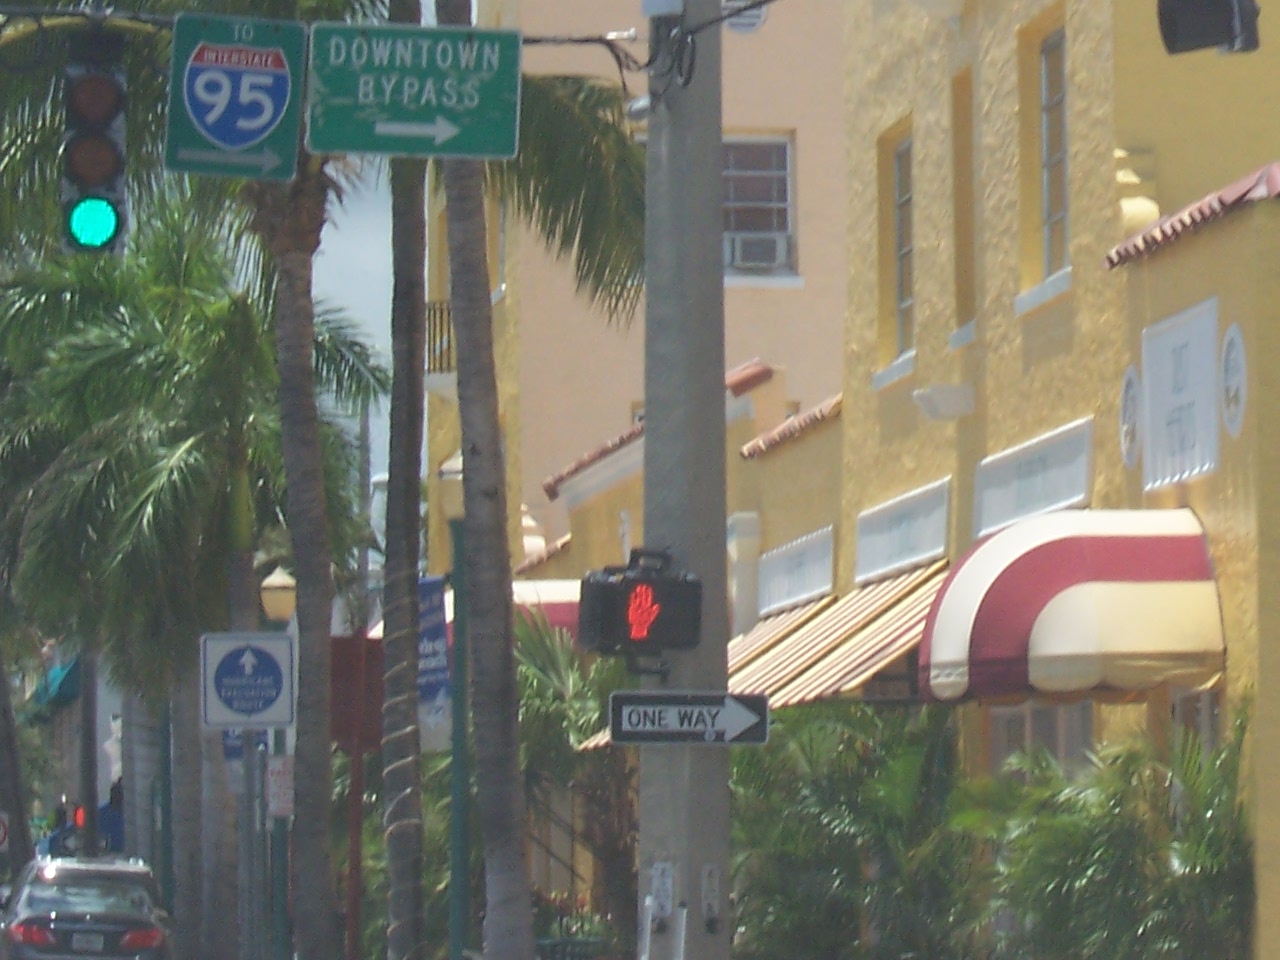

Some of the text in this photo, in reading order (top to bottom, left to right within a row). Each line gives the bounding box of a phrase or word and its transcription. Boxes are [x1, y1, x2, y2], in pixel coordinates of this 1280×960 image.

[234, 24, 254, 41] TO
[203, 48, 273, 69] INTERSTATE
[329, 34, 500, 72] DOWNTOWN
[194, 69, 275, 131] 95
[357, 74, 480, 108] BYPASS
[627, 706, 721, 728] ONE WAY
